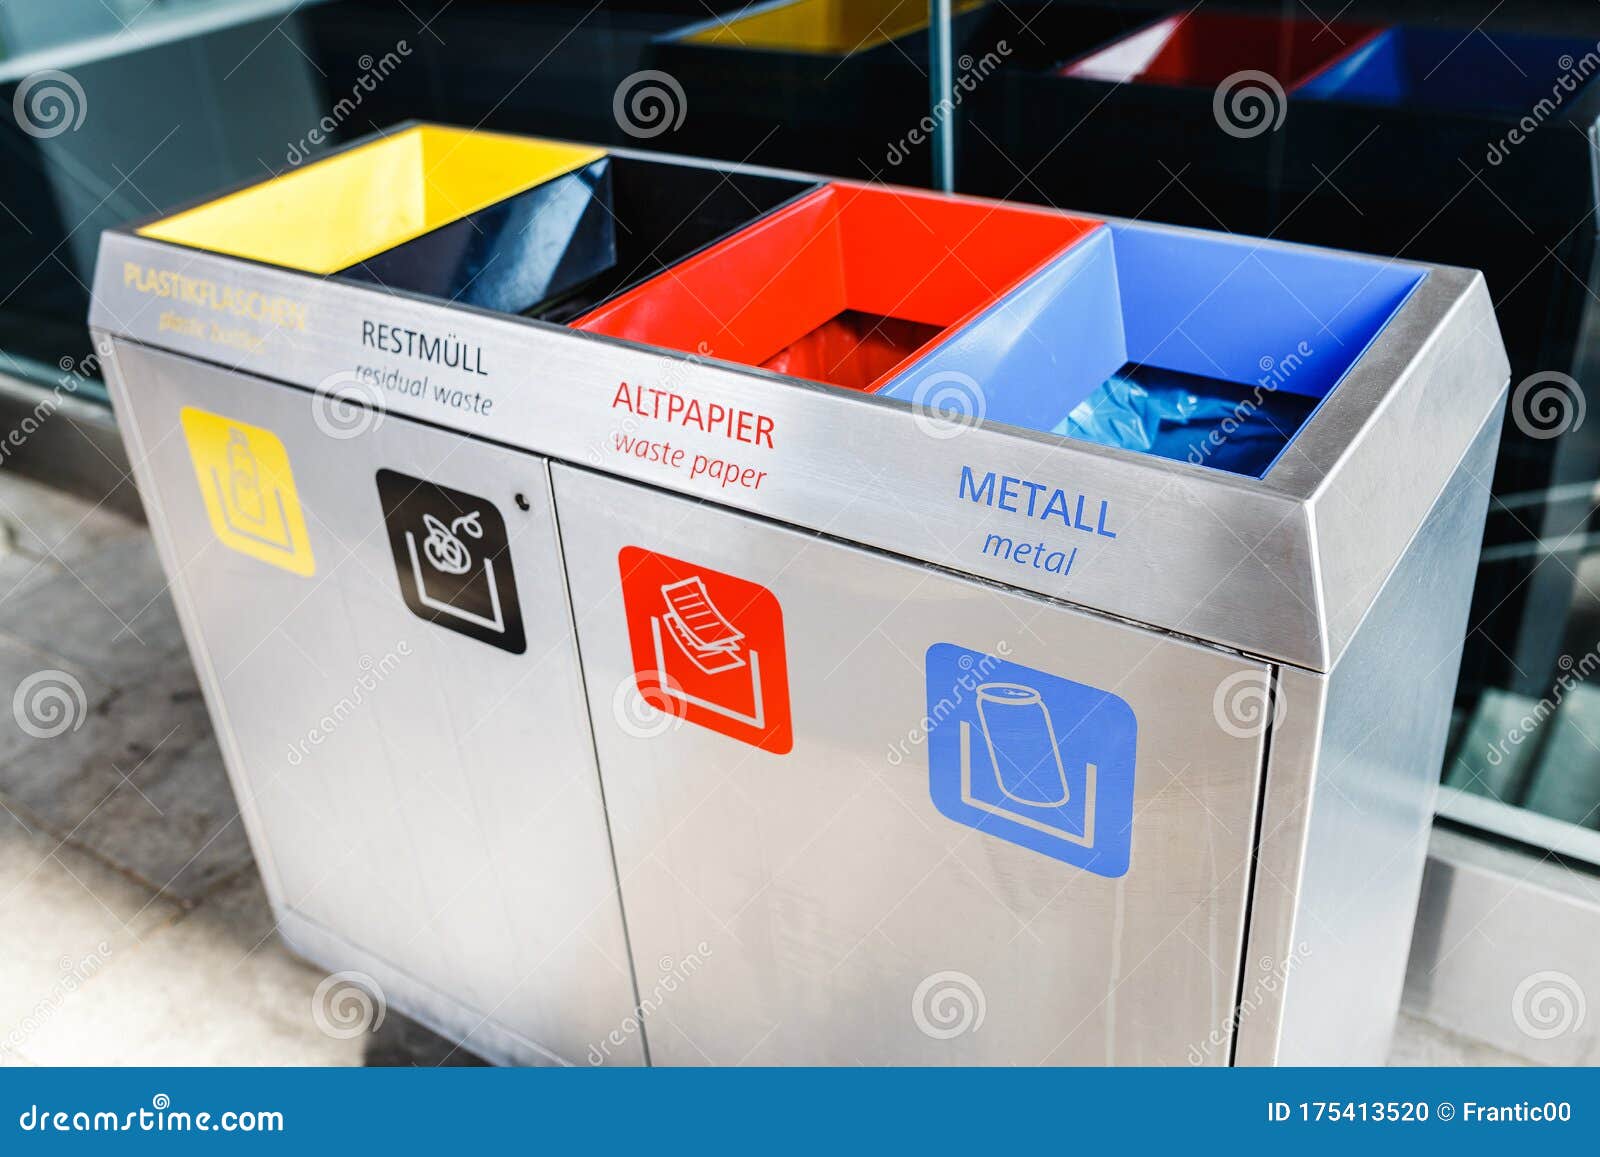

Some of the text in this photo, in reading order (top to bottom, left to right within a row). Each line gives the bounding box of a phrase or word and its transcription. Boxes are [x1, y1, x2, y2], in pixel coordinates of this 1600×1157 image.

[123, 261, 305, 331] PLASTIKFLASCHEN
[362, 320, 488, 376] RESTMÜLL
[356, 364, 493, 416] residual waste
[612, 381, 775, 449] ALTPAPIER
[615, 433, 767, 490] waste paper
[959, 465, 1117, 539] METALL
[982, 533, 1077, 576] metal
